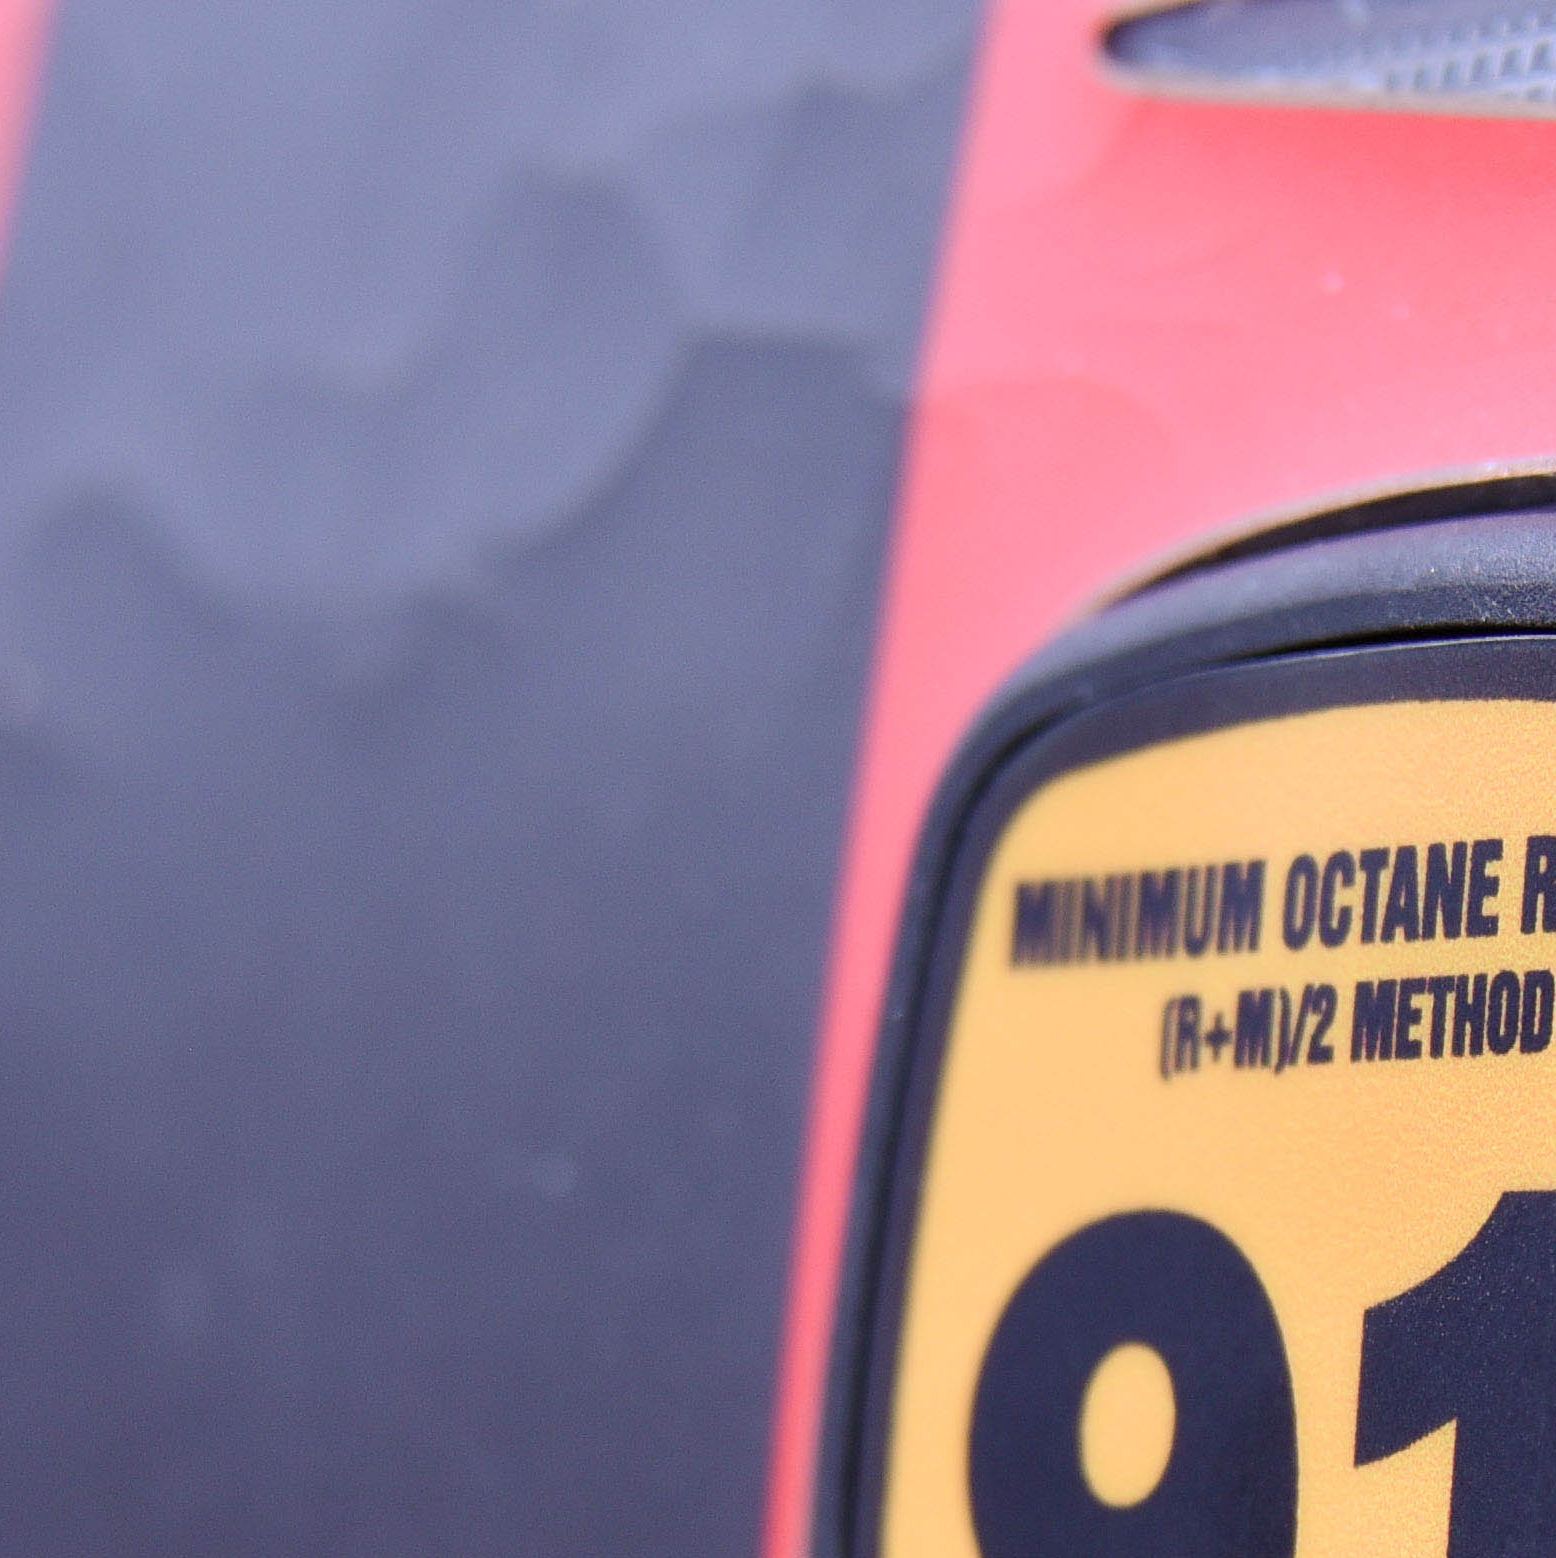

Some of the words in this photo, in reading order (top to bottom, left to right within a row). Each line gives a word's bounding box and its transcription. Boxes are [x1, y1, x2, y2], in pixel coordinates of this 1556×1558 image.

[1011, 860, 1267, 970] MINIMUM
[1281, 837, 1504, 951] OCTANE
[1159, 983, 1338, 1084] (R+M)/2
[1349, 968, 1555, 1063] METHOD
